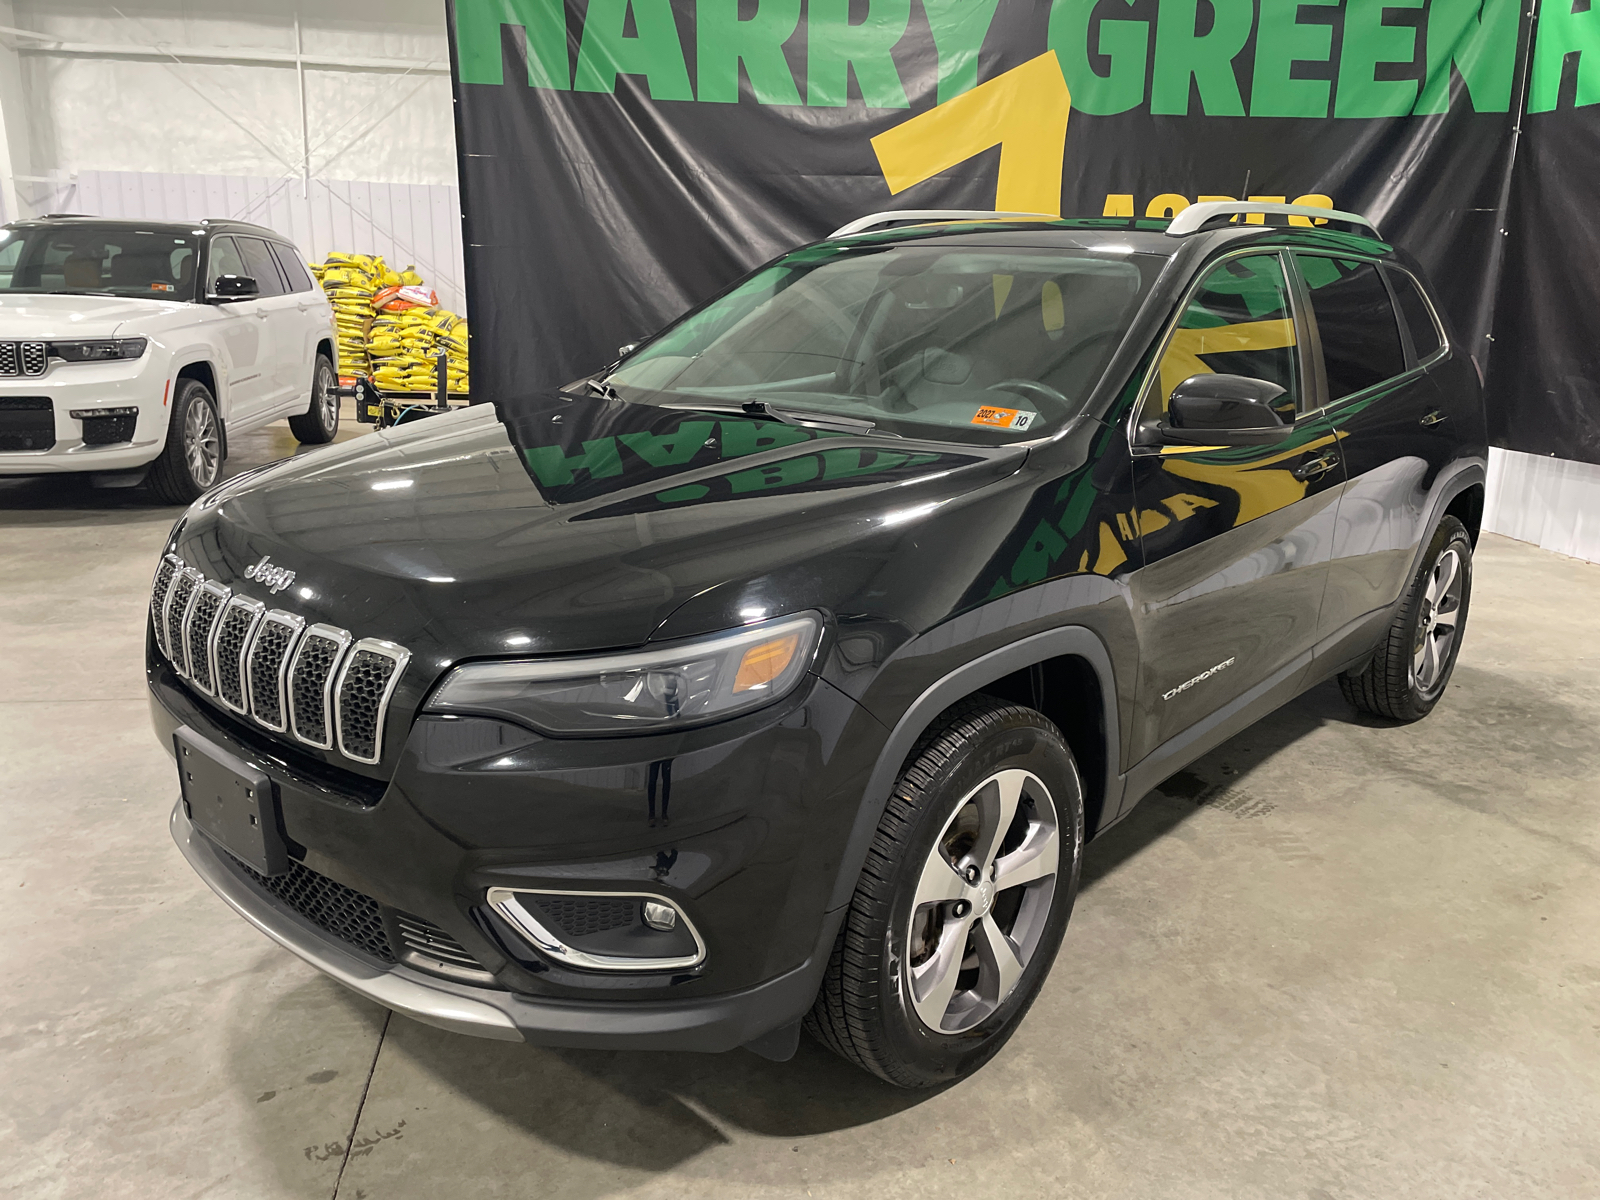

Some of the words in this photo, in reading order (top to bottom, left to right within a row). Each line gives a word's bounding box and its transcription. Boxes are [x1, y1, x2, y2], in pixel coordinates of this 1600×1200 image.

[457, 0, 1001, 109] HARRY
[1047, 0, 1520, 118] GREEN
[976, 408, 996, 419] 2027
[1015, 415, 1028, 427] 10
[244, 555, 296, 594] Jeep
[1162, 656, 1235, 700] CHEROKEE
